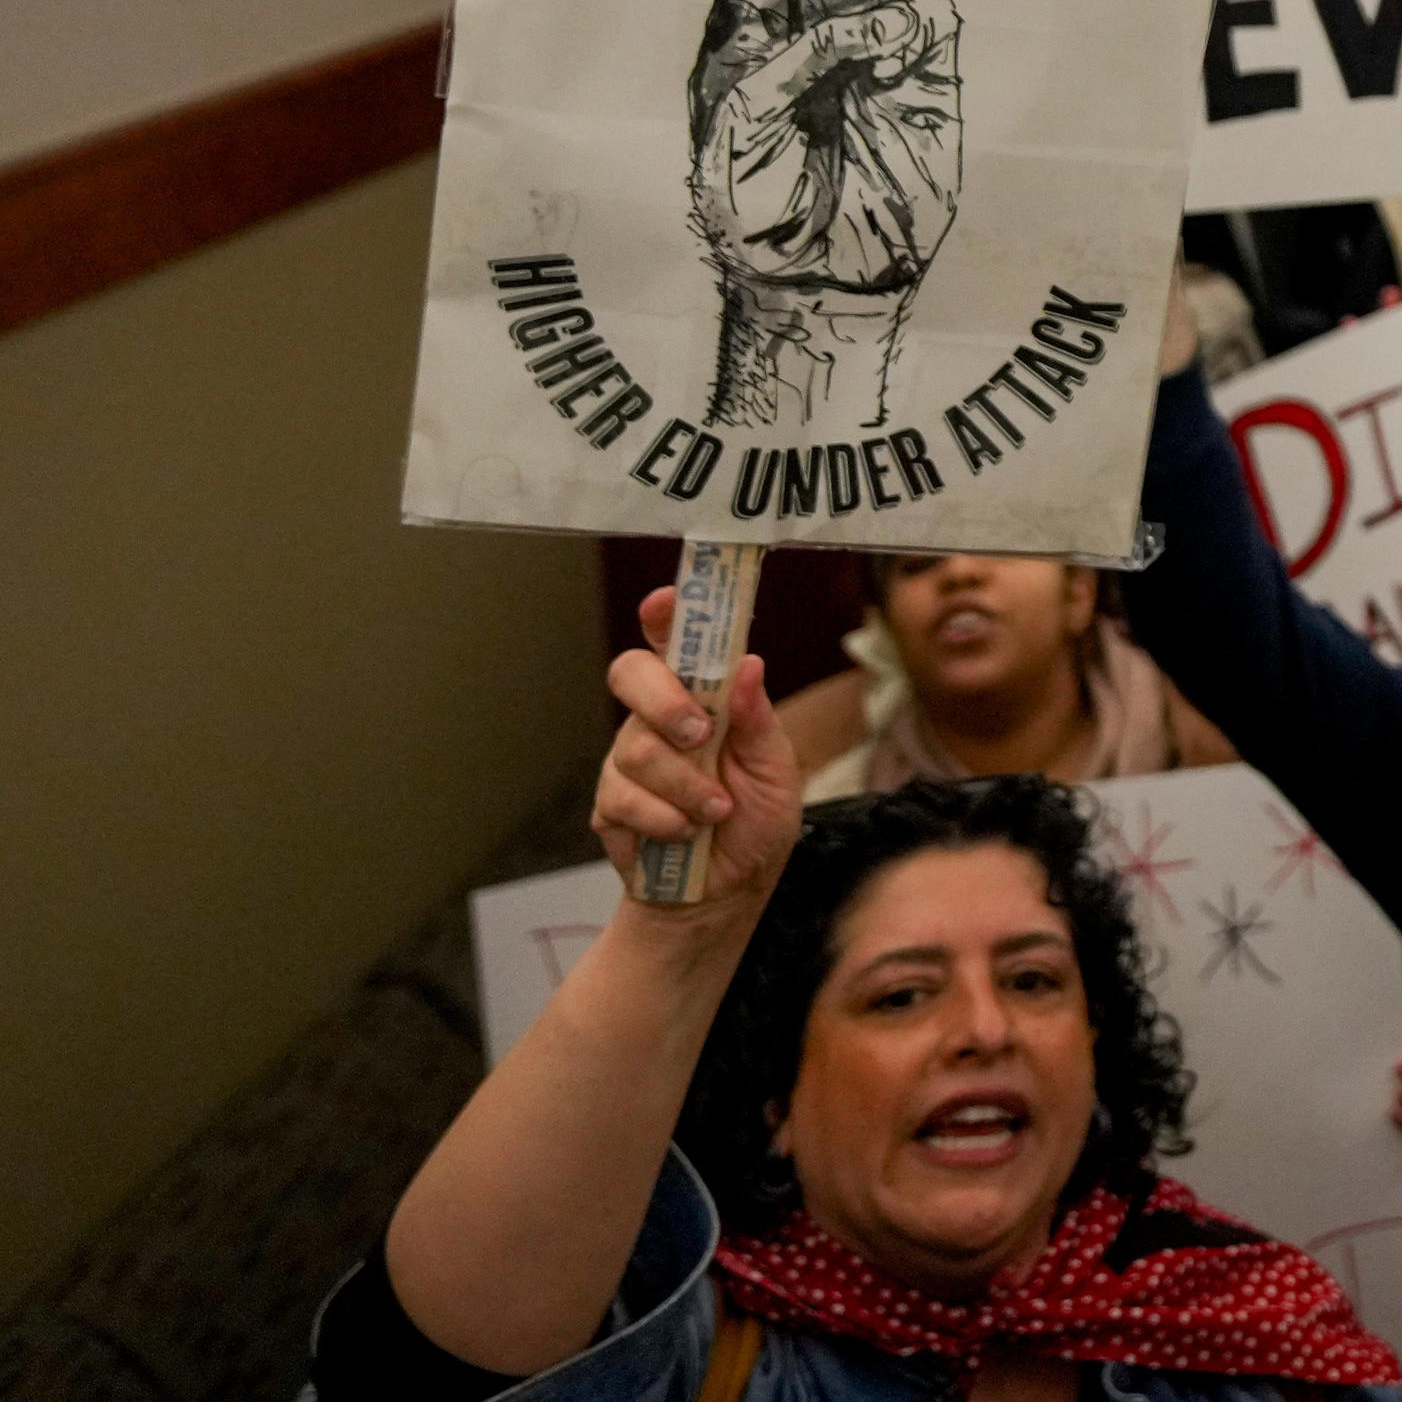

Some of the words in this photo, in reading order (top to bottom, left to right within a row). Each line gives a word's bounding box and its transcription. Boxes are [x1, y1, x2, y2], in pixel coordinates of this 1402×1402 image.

[487, 253, 655, 450] HIGHER
[630, 416, 724, 503] ED
[729, 426, 944, 520] UNDER
[942, 283, 1128, 475] ATTACK
